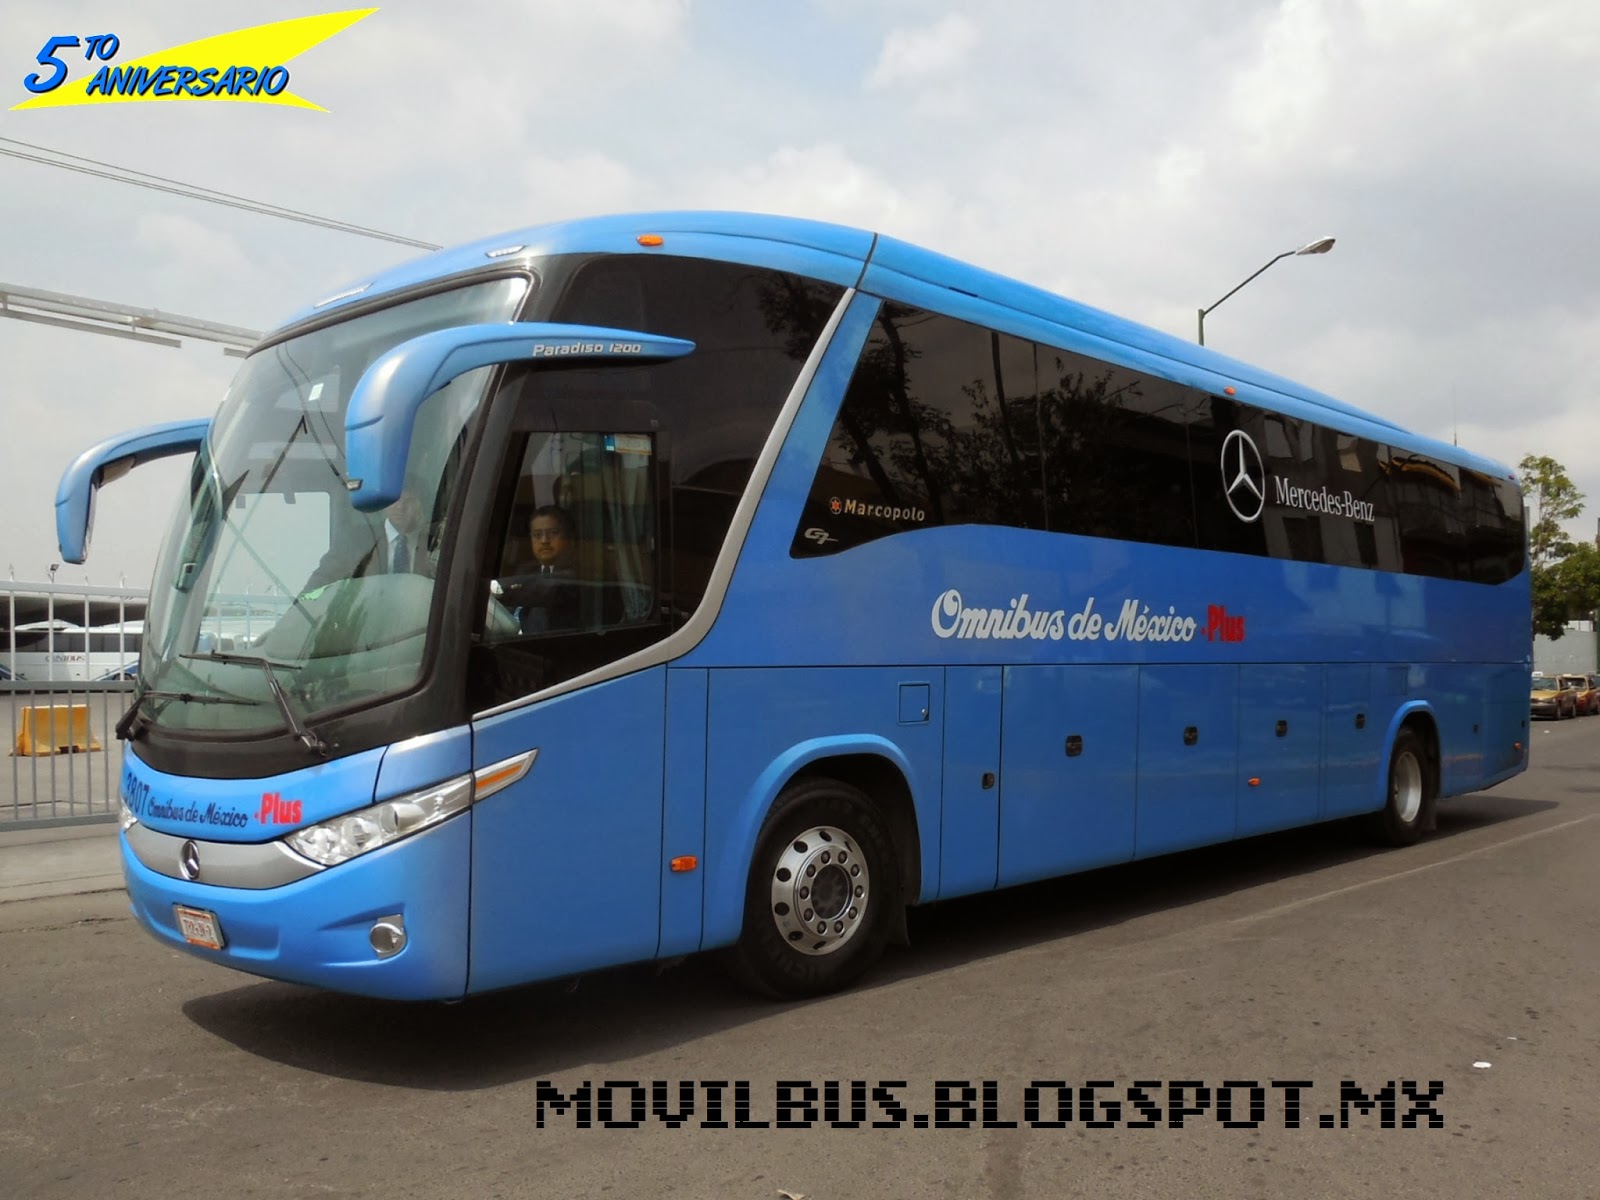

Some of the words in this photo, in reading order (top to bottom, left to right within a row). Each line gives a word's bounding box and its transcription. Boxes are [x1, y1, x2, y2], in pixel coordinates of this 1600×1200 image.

[532, 342, 603, 357] Paradiso
[609, 343, 642, 353] 1200
[844, 499, 925, 522] Marcopolo
[1274, 475, 1375, 522] Mercedes-Benz
[931, 589, 1065, 640] Omnibus
[1068, 597, 1101, 640] de
[1104, 599, 1197, 642] México
[1206, 604, 1245, 642] Plus
[147, 796, 185, 821] Omnibus
[185, 801, 199, 823] de
[199, 802, 248, 828] México
[260, 792, 303, 825] Plus
